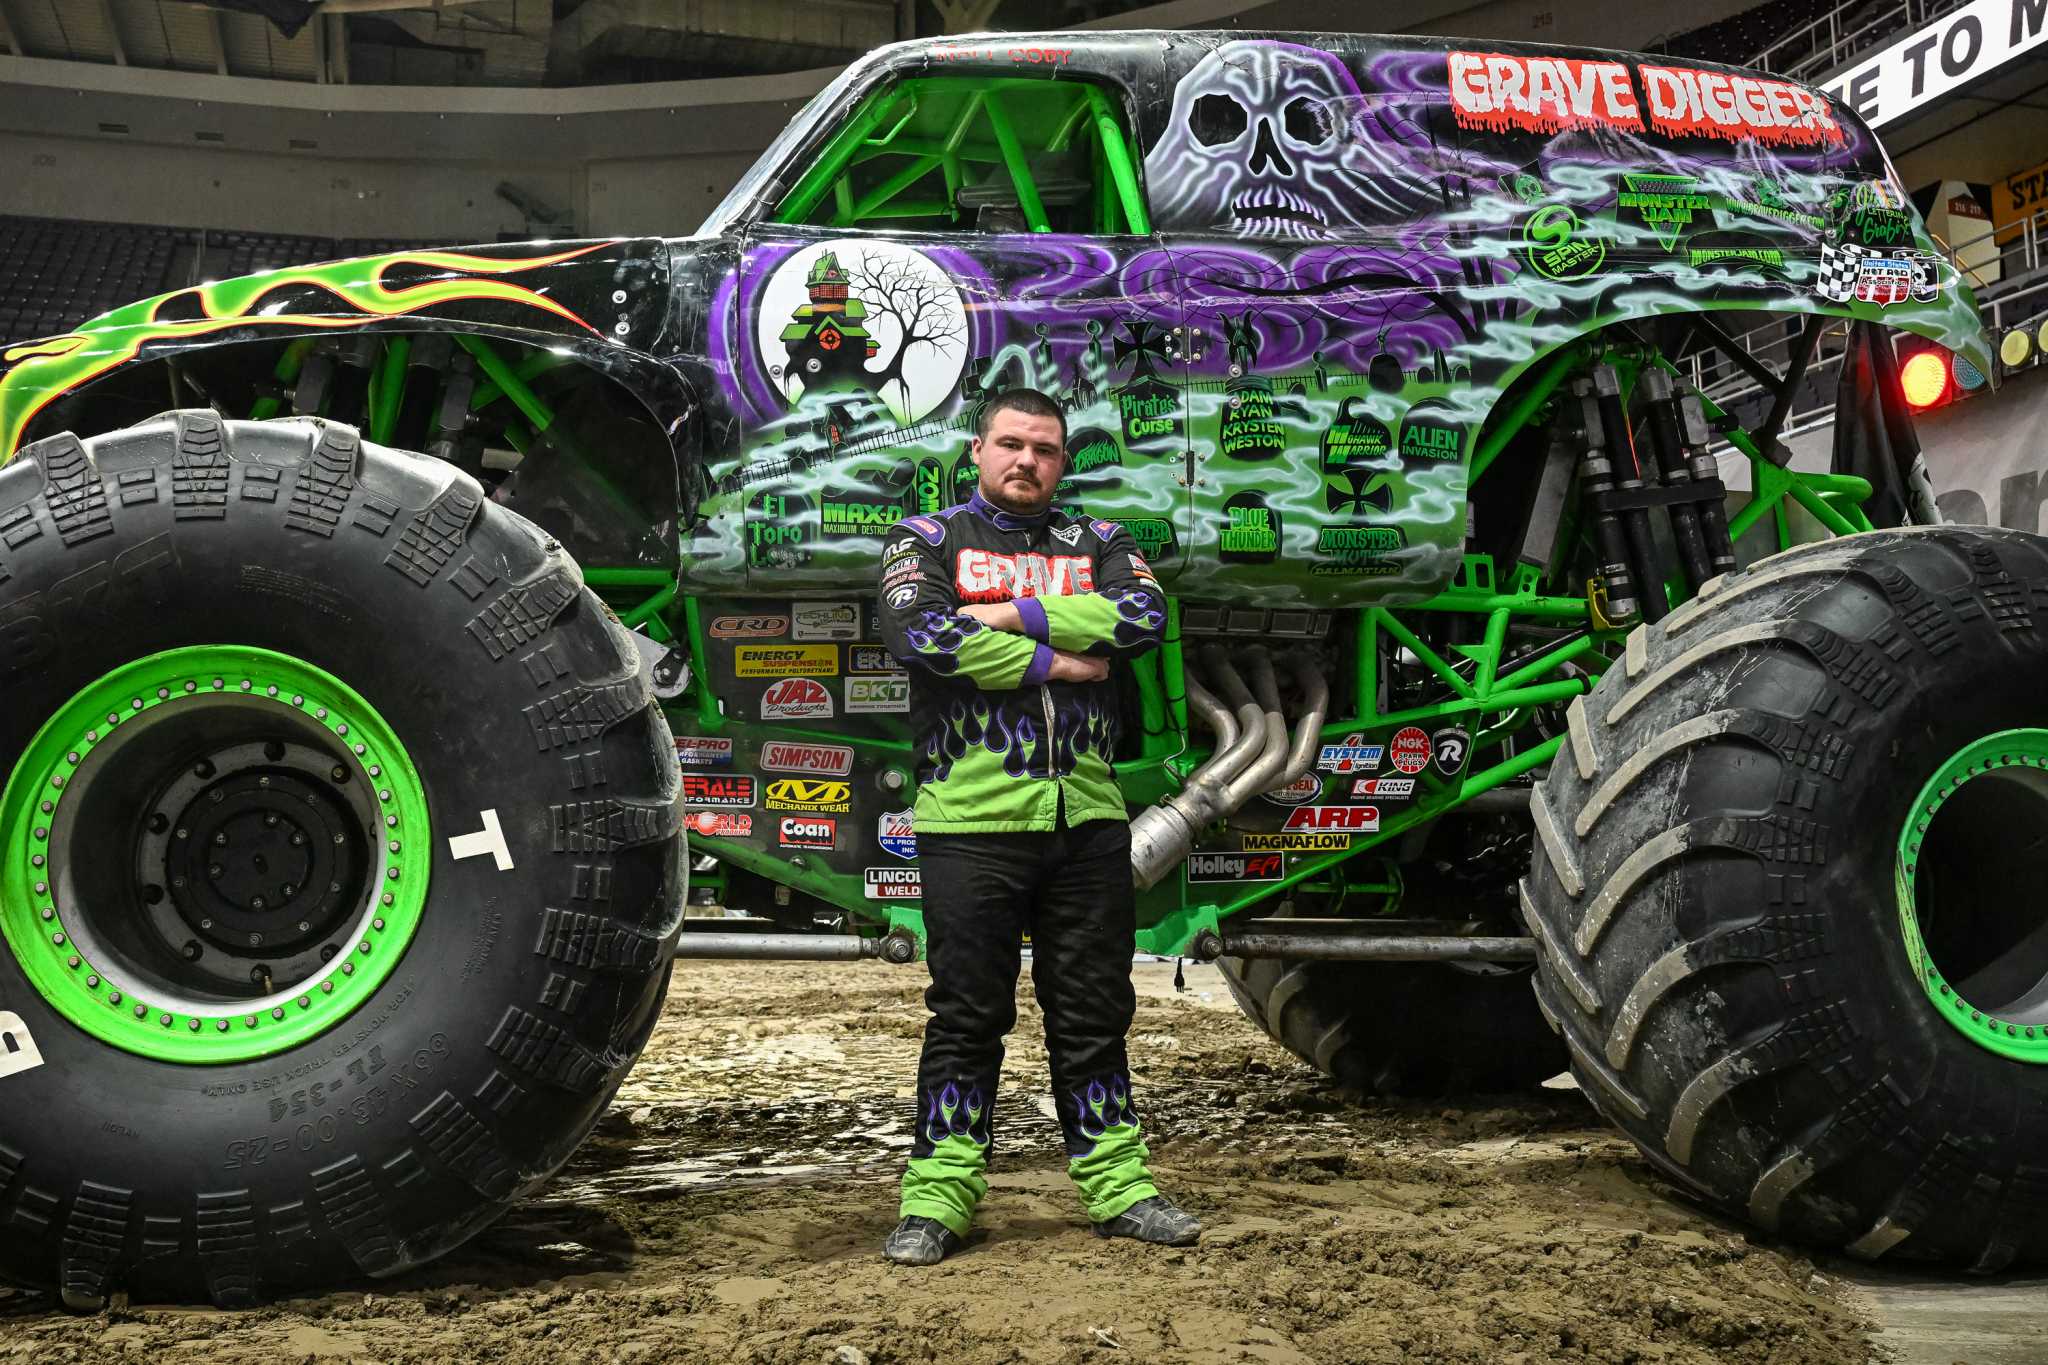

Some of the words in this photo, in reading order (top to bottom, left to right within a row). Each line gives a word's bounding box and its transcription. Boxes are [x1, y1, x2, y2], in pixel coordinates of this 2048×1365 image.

[1008, 48, 1072, 65] CODY
[1903, 15, 1982, 98] TO
[1449, 53, 1638, 119] GRAVE
[1643, 66, 1835, 130] DIGGER
[1618, 193, 1712, 209] MONSTER
[1641, 208, 1692, 223] JAM
[1543, 237, 1592, 268] SPIN
[1552, 247, 1598, 276] MASTER
[1691, 248, 1783, 267] MONSTERJAM.COM
[1121, 394, 1177, 419] Pirate's
[1233, 389, 1273, 405] DAM
[1230, 404, 1273, 421] RYAN
[1129, 417, 1174, 439] Curse
[1222, 420, 1285, 439] KRYSTEN
[1327, 425, 1383, 444] MOHAWK
[1224, 434, 1285, 454] WESTON
[1403, 425, 1459, 451] ALIEN
[1402, 445, 1458, 460] INVASION
[918, 466, 940, 513] ZOM
[1229, 507, 1269, 529] BLUE
[748, 521, 802, 546] Toro
[823, 524, 857, 534] MAXIMUM
[861, 525, 889, 535] DESTRUC
[1122, 520, 1169, 540] NSTER
[1321, 529, 1400, 549] MONSTER
[1221, 530, 1276, 552] THUNDER
[959, 549, 1094, 598] GRAVE
[1313, 567, 1400, 576] DALMATIAN
[715, 619, 786, 631] CRD
[742, 650, 806, 661] ENERGY
[762, 660, 834, 668] SUSPENSION
[767, 679, 827, 704] JAZ
[851, 682, 907, 699] BKT
[766, 702, 826, 714] Products
[676, 738, 730, 750] EL-PRO
[1322, 748, 1381, 759] SYSTEM
[1398, 738, 1424, 750] NGK
[769, 747, 845, 769] SIMPSON
[1378, 781, 1412, 792] KING
[686, 796, 750, 804] FORMANCE
[766, 799, 818, 812] MECHANIX
[820, 803, 849, 813] WEAR
[1286, 807, 1378, 828] ARP
[781, 818, 830, 837] Coan
[448, 808, 515, 871] T
[1244, 834, 1348, 849] MAGNAFLOW
[869, 871, 921, 883] LINCOL
[1191, 856, 1245, 879] Holley
[1247, 856, 1281, 877] EFI
[885, 886, 922, 896] WELD
